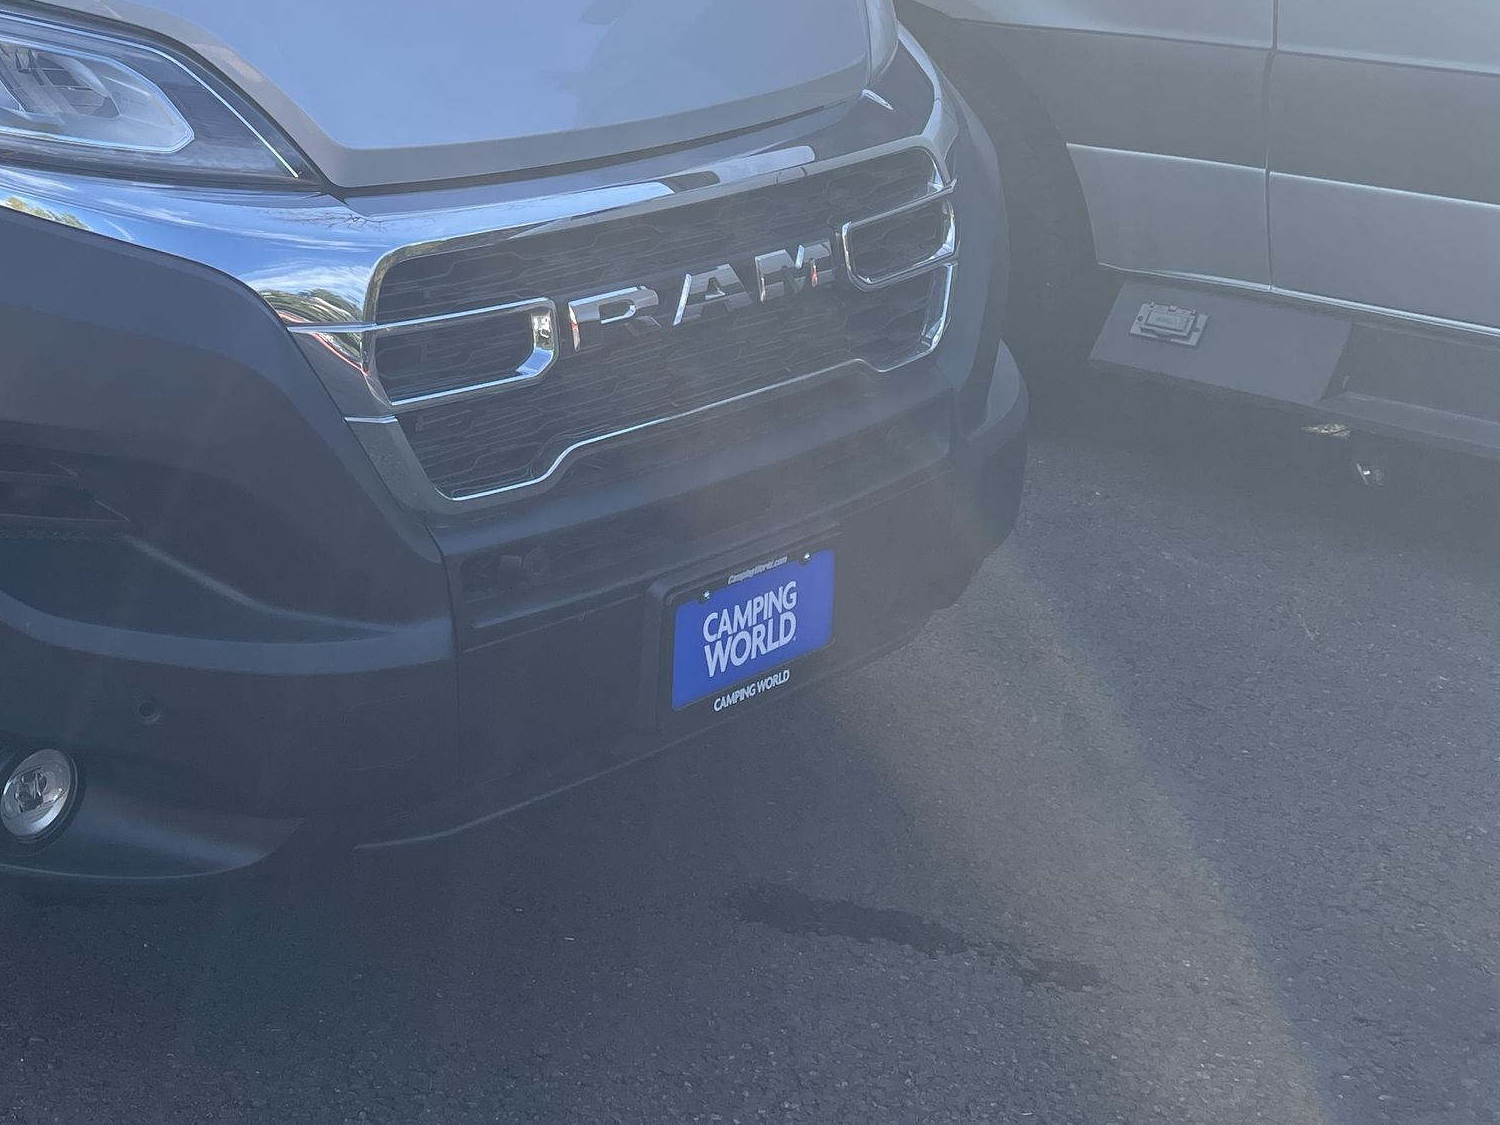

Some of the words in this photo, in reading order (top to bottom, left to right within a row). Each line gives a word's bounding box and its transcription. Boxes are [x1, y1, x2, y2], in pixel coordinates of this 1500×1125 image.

[568, 238, 837, 353] RAM
[703, 581, 797, 642] CAMPING
[704, 612, 797, 678] WORLD
[714, 683, 757, 712] CAMPING
[757, 669, 790, 693] WORLD
